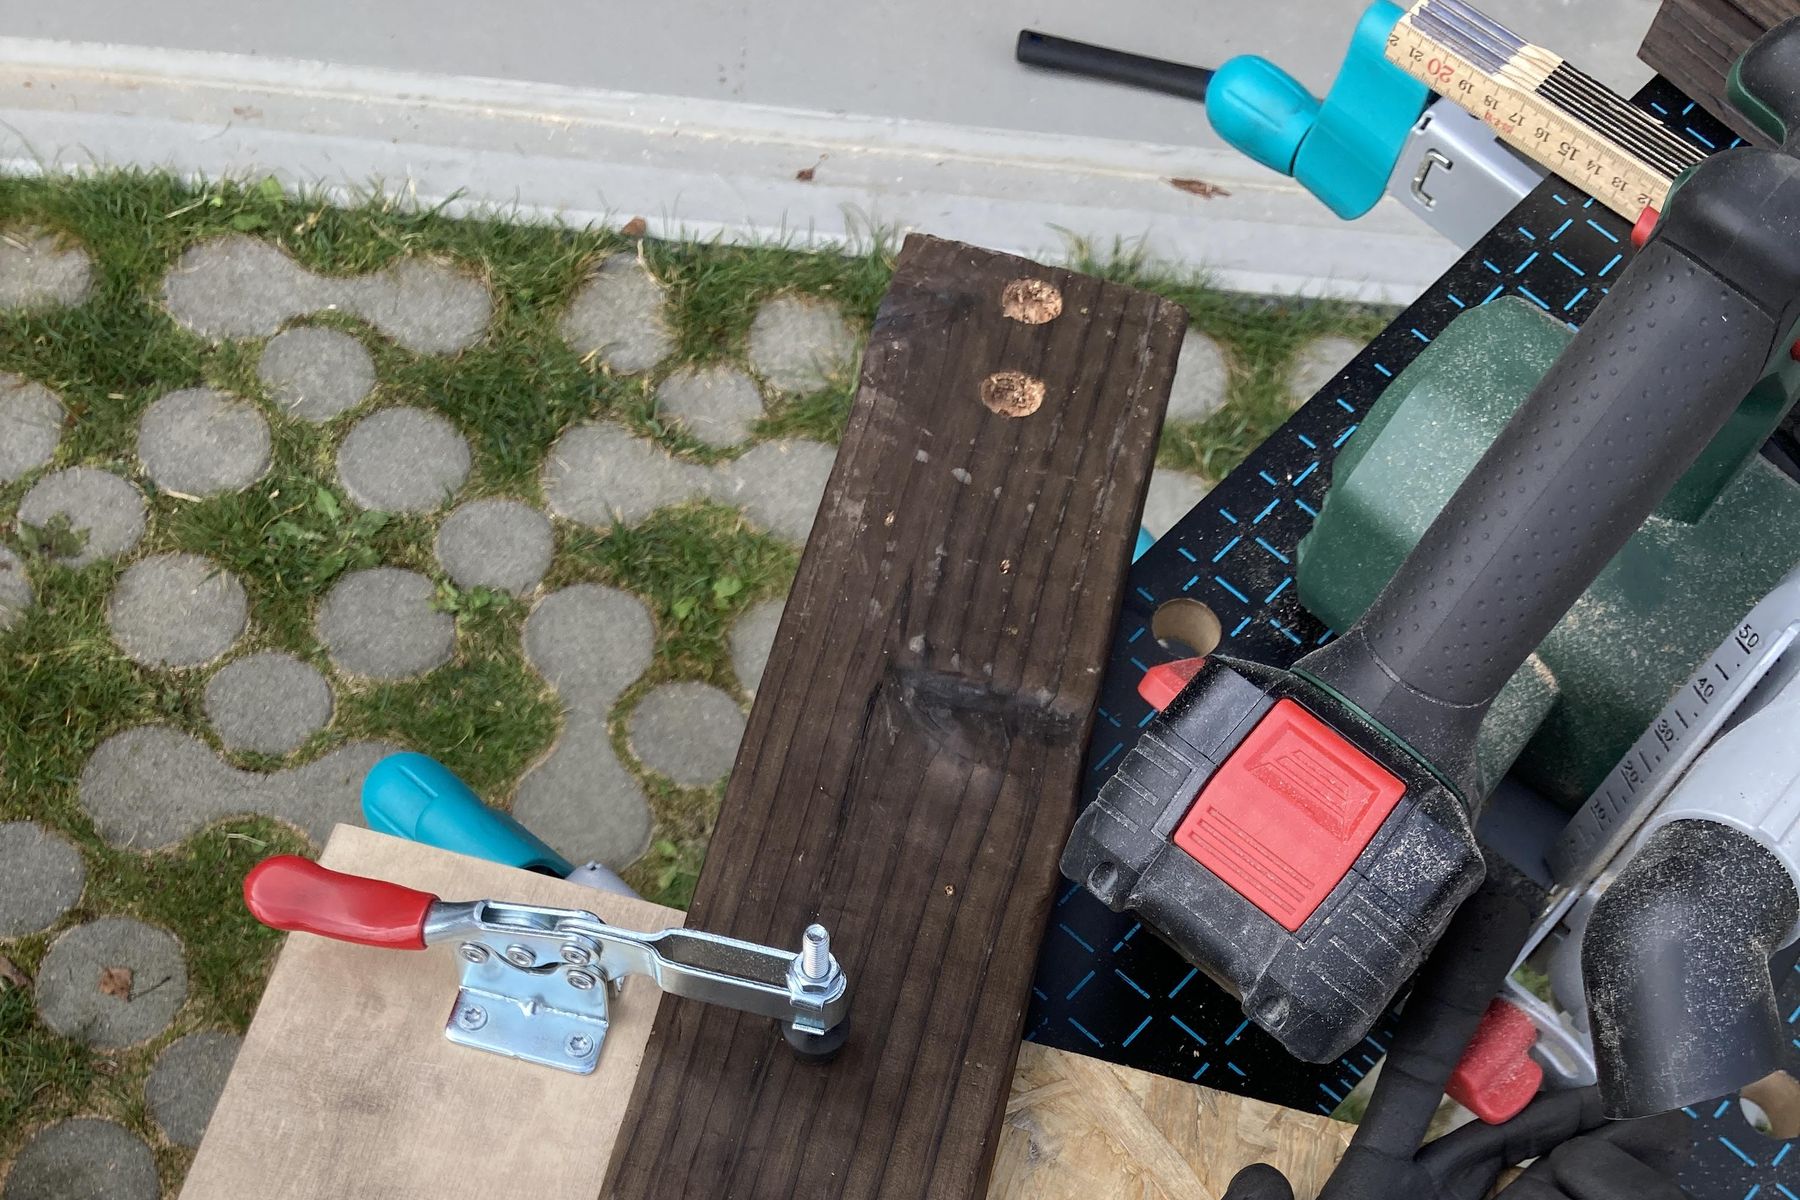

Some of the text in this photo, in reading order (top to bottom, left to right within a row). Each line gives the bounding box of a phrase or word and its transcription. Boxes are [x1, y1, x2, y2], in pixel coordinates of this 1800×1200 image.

[1409, 46, 1424, 62] 21
[1427, 58, 1455, 83] 20
[1458, 79, 1474, 94] 19
[1484, 95, 1498, 110] 18
[1508, 112, 1525, 126] 17
[1535, 127, 1550, 143] 16
[1558, 141, 1580, 161] 15
[1586, 160, 1602, 175] 14
[1611, 176, 1628, 192] 13
[1739, 624, 1759, 648] 50
[1697, 677, 1715, 697] 40
[1658, 719, 1674, 741] 30
